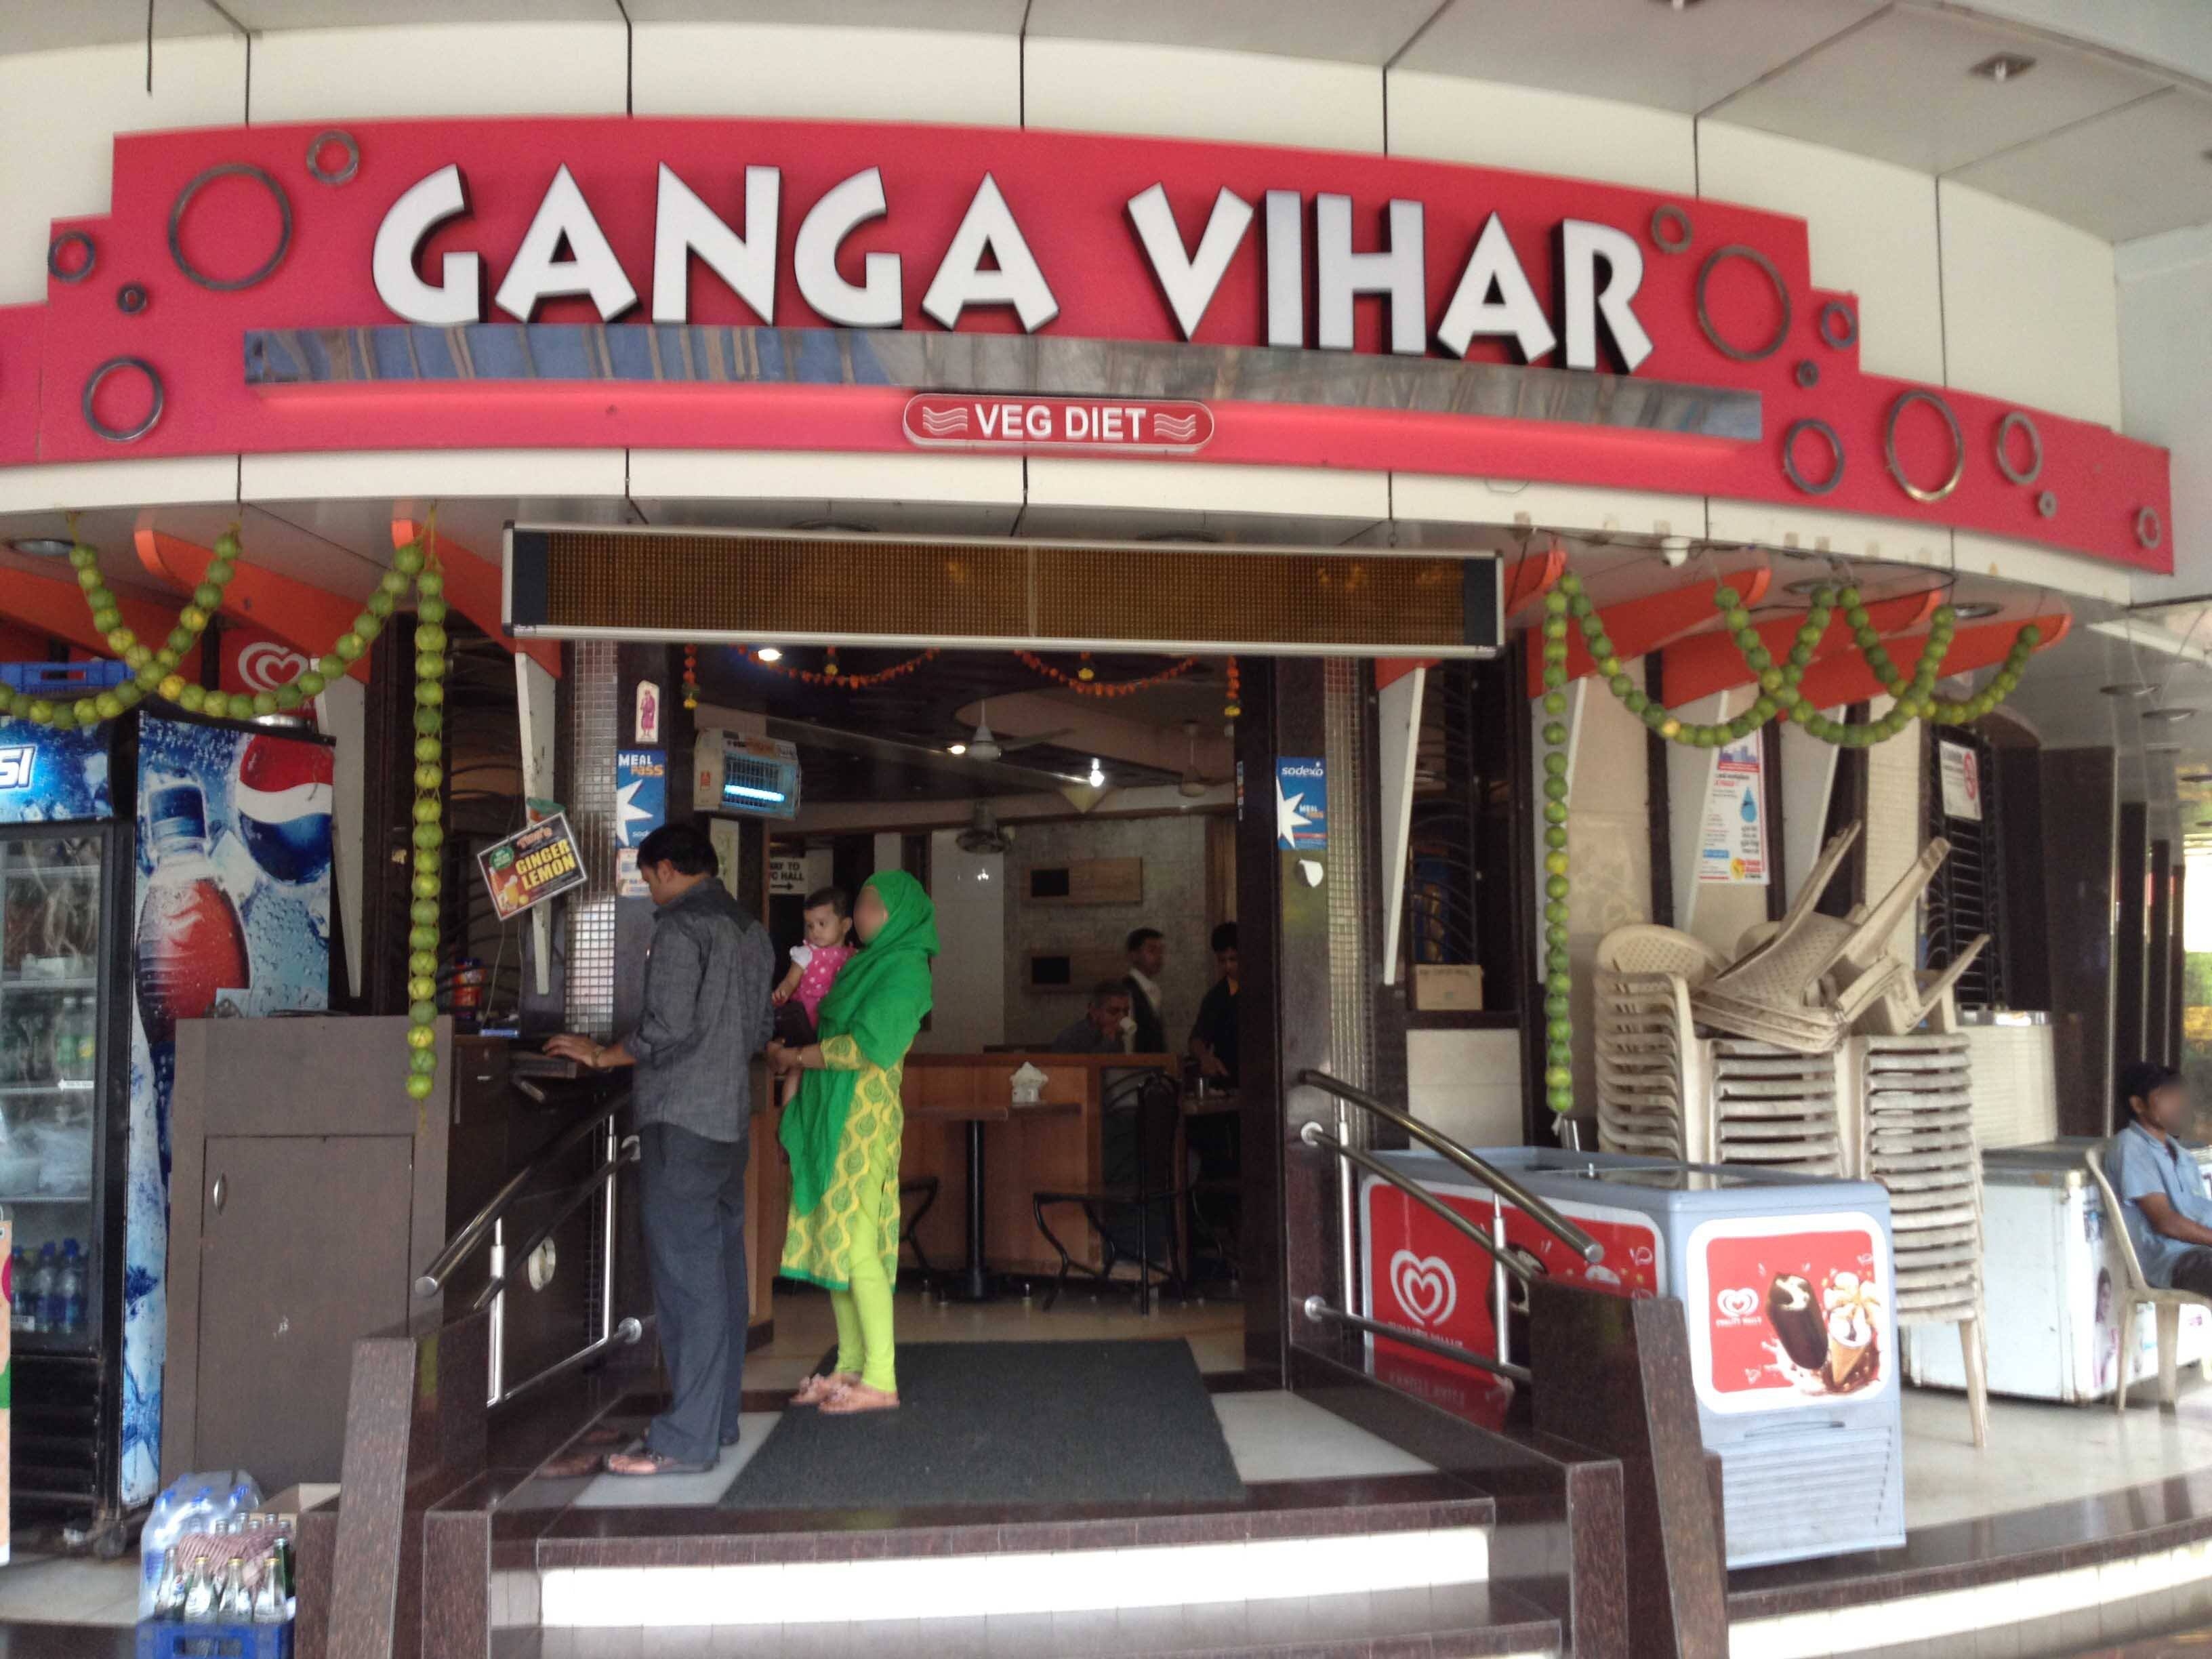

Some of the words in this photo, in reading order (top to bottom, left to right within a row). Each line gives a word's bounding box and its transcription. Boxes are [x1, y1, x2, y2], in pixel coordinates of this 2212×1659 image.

[372, 161, 1059, 333] GANGA
[1125, 181, 1654, 373] VIHAR
[975, 403, 1052, 440] VEG
[1065, 407, 1147, 443] DIET
[618, 754, 653, 767] MEAL
[1282, 764, 1324, 776] sodexo
[515, 838, 570, 876] GINGER
[787, 861, 800, 870] TO
[521, 853, 576, 890] LEMON
[780, 872, 804, 880] HALL
